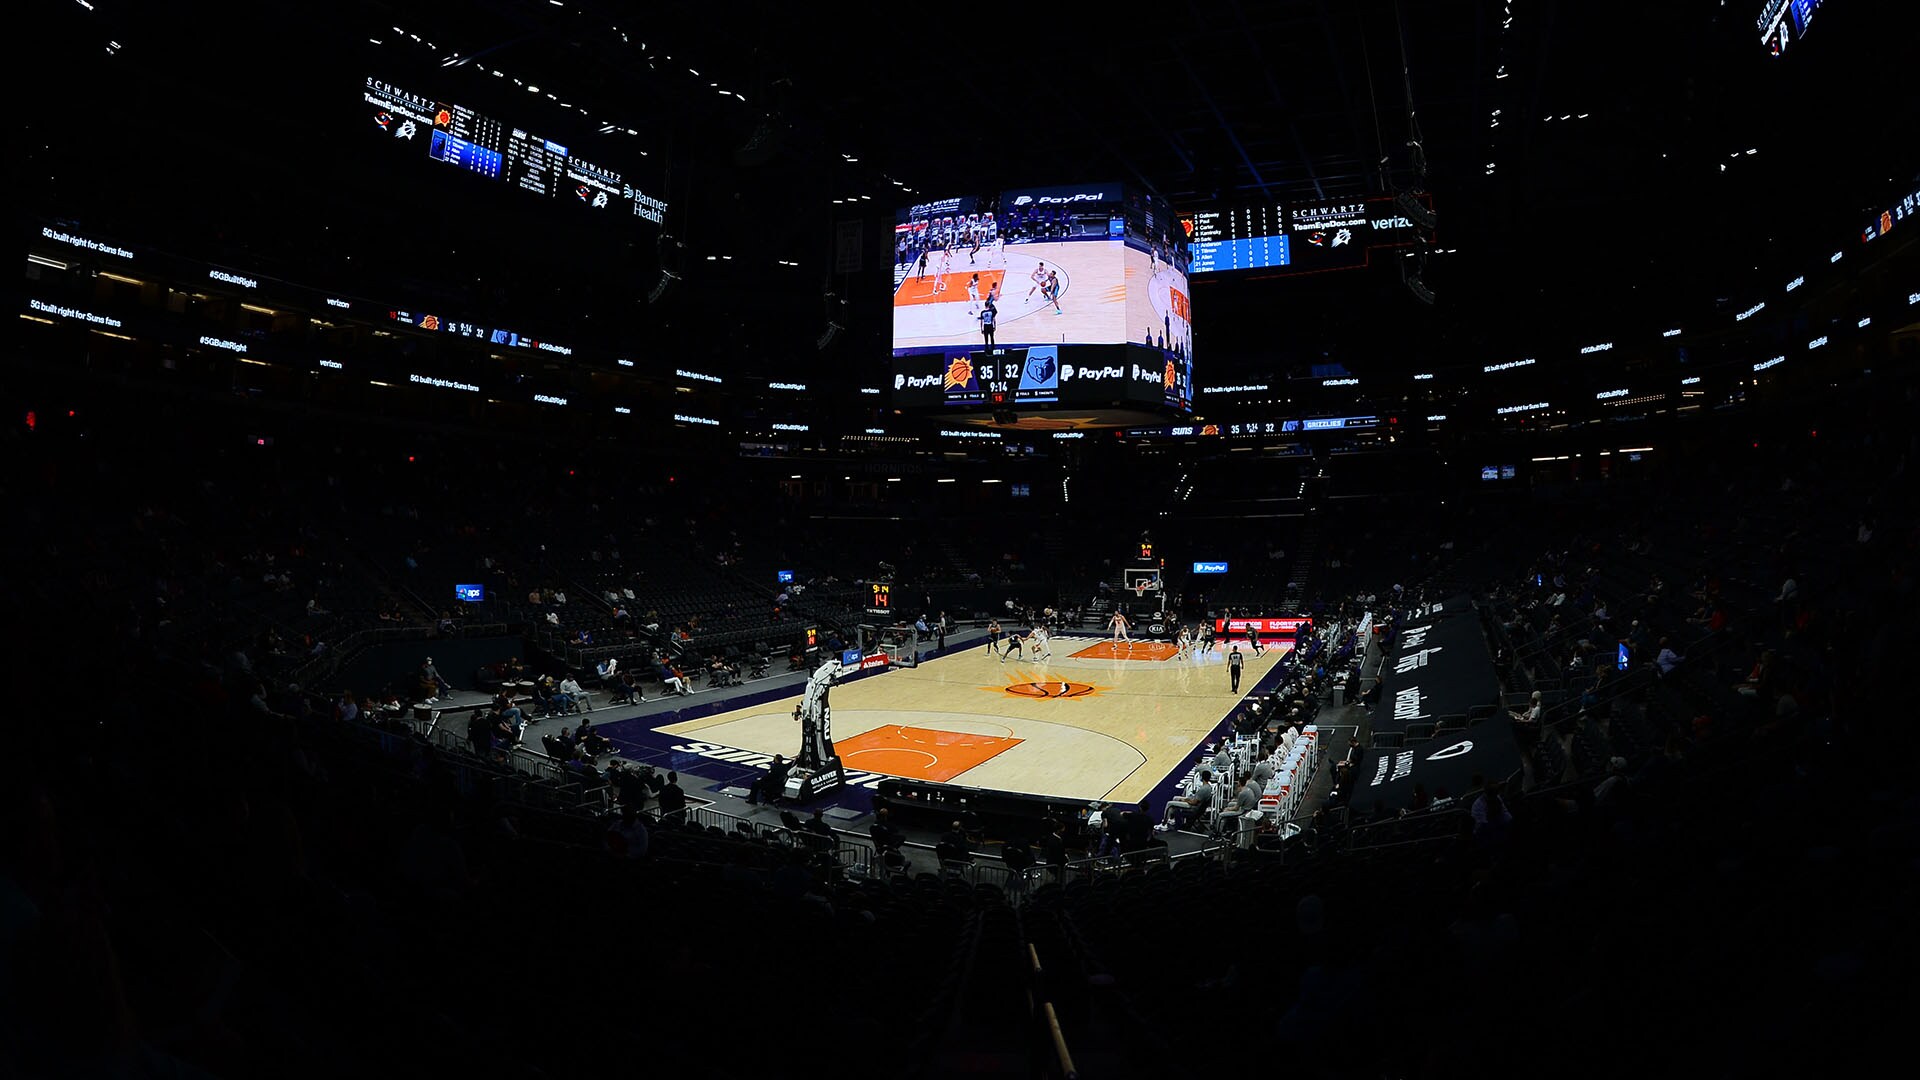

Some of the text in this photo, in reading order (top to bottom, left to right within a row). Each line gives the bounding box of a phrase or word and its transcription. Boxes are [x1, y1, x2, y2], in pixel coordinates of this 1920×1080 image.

[367, 77, 435, 110] SCHWARTZ
[364, 92, 433, 126] TeamEyeDoc.com
[568, 156, 621, 182] SCHWARTZ
[567, 169, 620, 195] TeamEyeDoc.com
[634, 189, 668, 212] Banner
[1039, 193, 1103, 204] PayPal
[633, 203, 663, 224] Health
[1292, 204, 1365, 218] SCHWARTZ
[1293, 219, 1366, 231] TeamEyeDoc.com
[42, 227, 134, 259] 5G built right for Suns fans
[210, 270, 257, 288] #5GBuiltRight
[327, 298, 349, 309] verizon
[30, 299, 121, 327] 5G built right for Suns fans
[448, 322, 456, 332] 35
[460, 322, 472, 333] 9:14
[476, 328, 484, 338] 32
[1663, 328, 1682, 338] verizon
[200, 336, 247, 352] #5GBuiltRight
[320, 359, 342, 369] verizon
[618, 359, 634, 367] verizon
[980, 364, 1019, 380] 35 32
[1079, 366, 1124, 381] PayPal
[1141, 368, 1162, 384] PayPal
[410, 374, 480, 392] 5G built right for Suns fans
[907, 374, 943, 389] PayPal
[990, 381, 1008, 392] 9:14
[1682, 376, 1701, 385] verizon
[1172, 427, 1193, 436] SUNS
[1231, 424, 1240, 435] 35
[1265, 423, 1274, 433] 32
[1307, 420, 1341, 428] GRIZZLIES
[1204, 564, 1226, 572] PayPal
[467, 589, 481, 598] aps
[872, 584, 889, 594] 9:14
[875, 594, 888, 607] 14
[1394, 685, 1428, 720] verizon
[671, 741, 793, 771] SUN
[822, 770, 837, 781] RIVER
